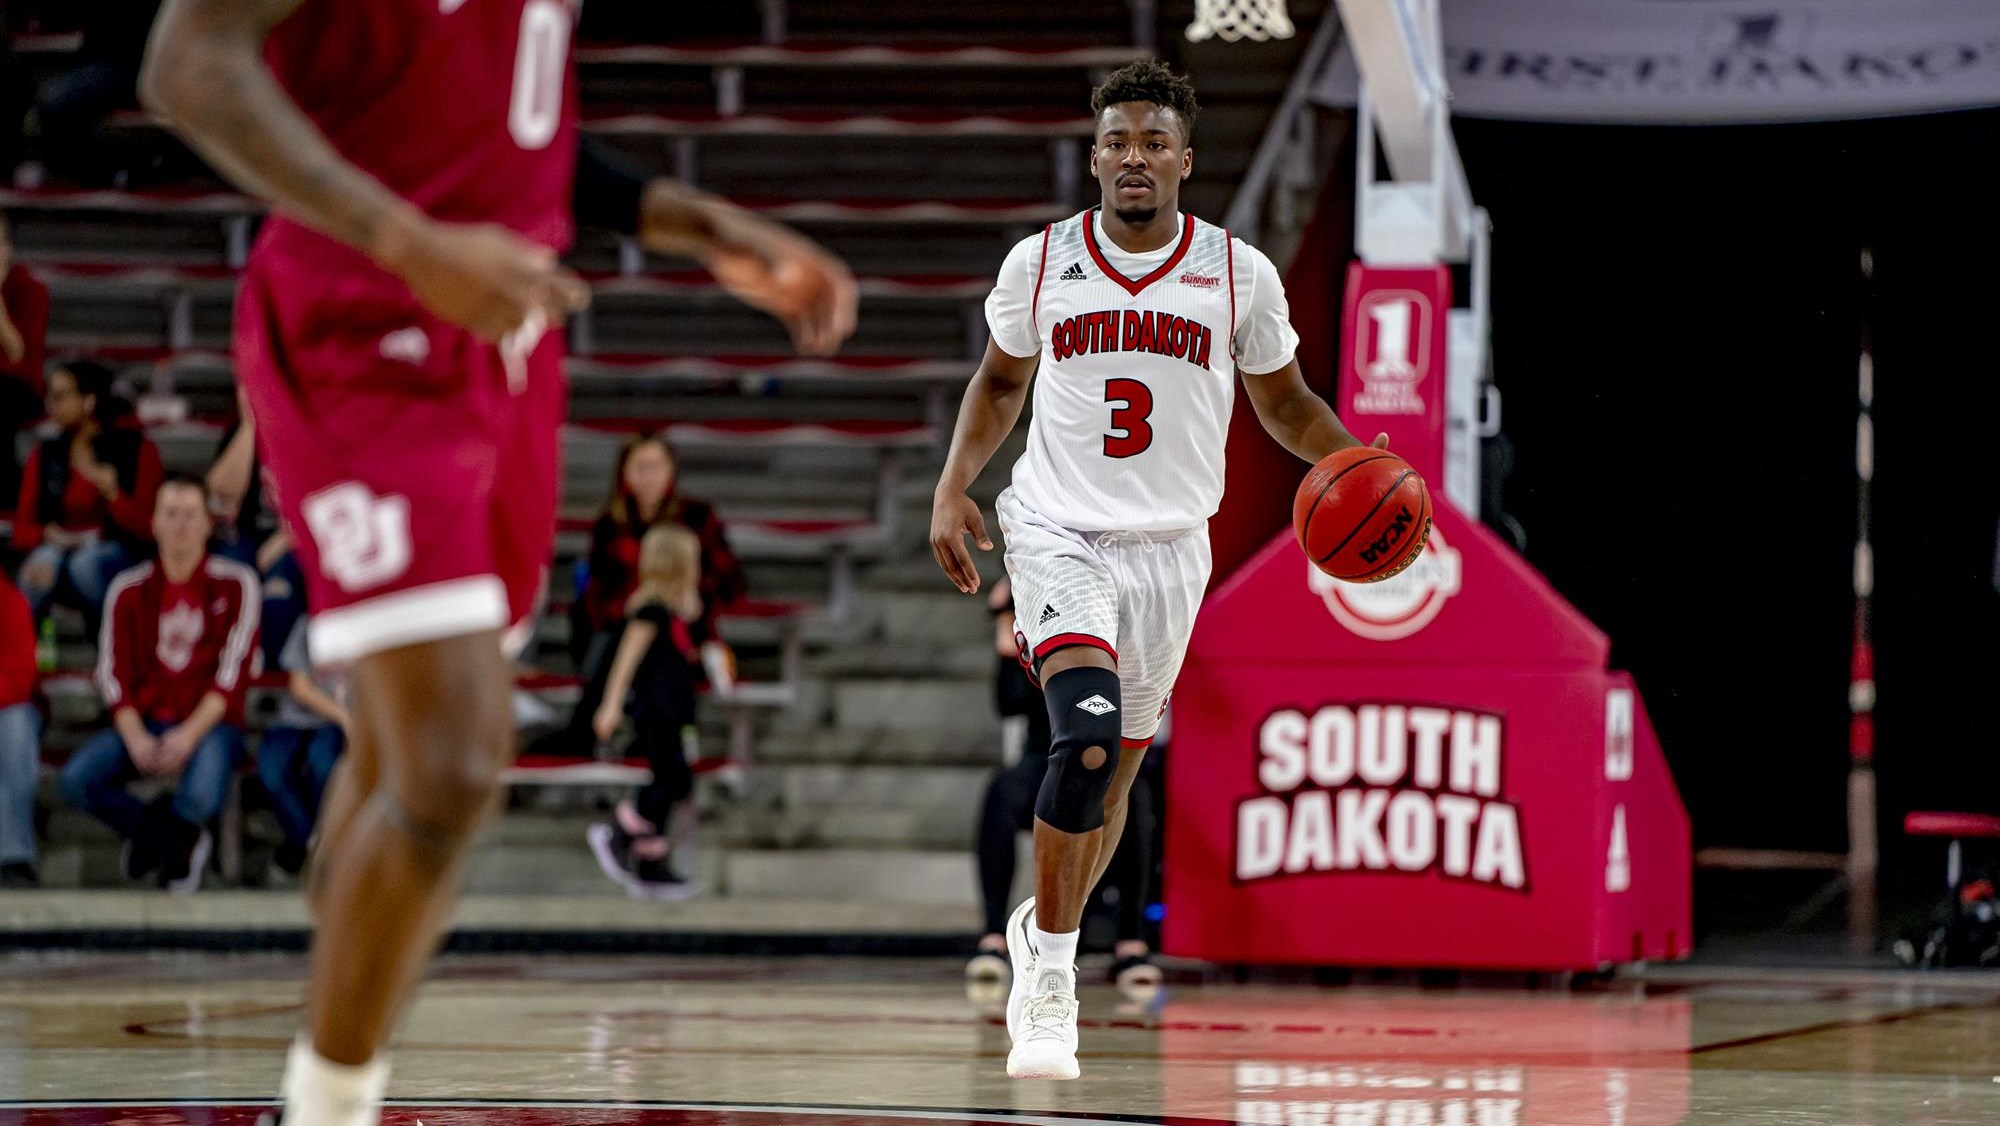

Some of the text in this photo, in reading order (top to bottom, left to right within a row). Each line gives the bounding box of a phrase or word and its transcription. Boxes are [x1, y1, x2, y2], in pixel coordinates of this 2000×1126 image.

[507, 0, 573, 150] 0
[1442, 47, 1686, 88] IRST
[1060, 272, 1087, 281] adidas
[1180, 274, 1221, 287] SUMMIT
[1051, 309, 1212, 371] SOUTH DAKOTA
[1102, 377, 1154, 459] 3
[1359, 505, 1413, 564] NCAA
[1257, 702, 1504, 798] SOUTH
[1235, 788, 1527, 891] DAKOTA
